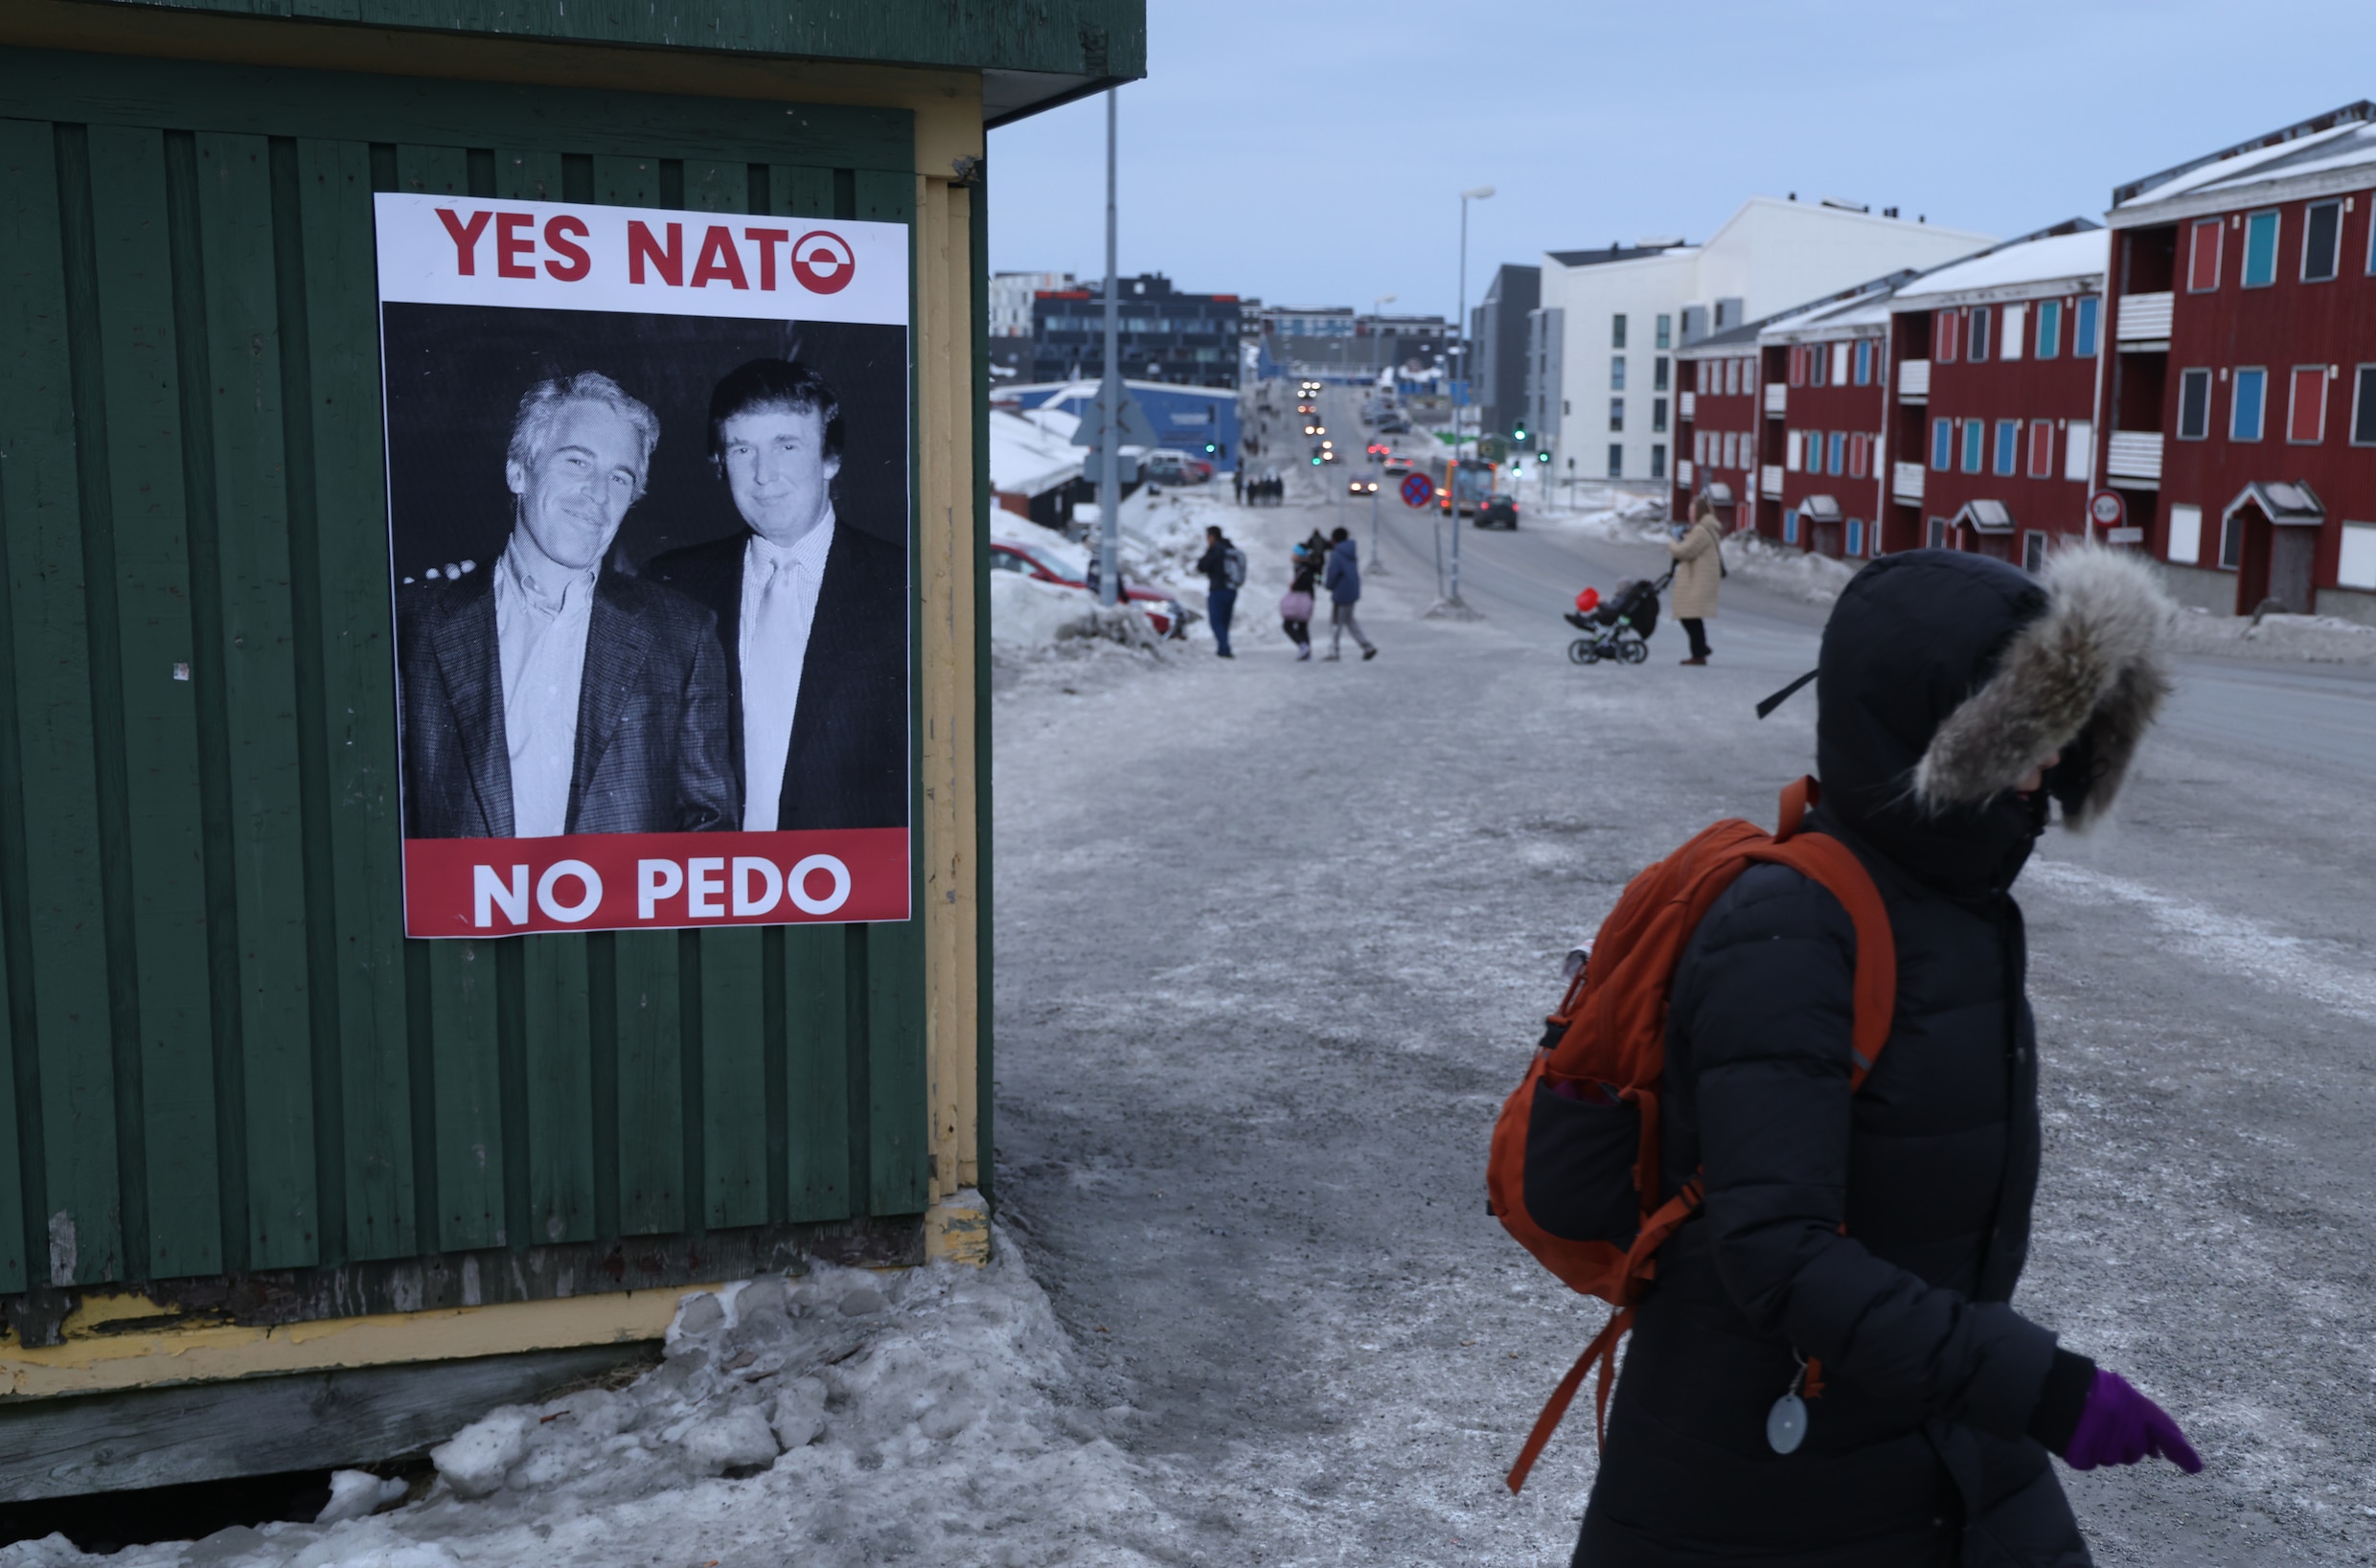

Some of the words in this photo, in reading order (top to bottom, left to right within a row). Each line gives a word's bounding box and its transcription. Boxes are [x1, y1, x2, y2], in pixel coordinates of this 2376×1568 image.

[435, 208, 591, 283] YES
[628, 219, 856, 295] NATO
[473, 859, 604, 927] NO
[637, 853, 852, 920] PEDO
